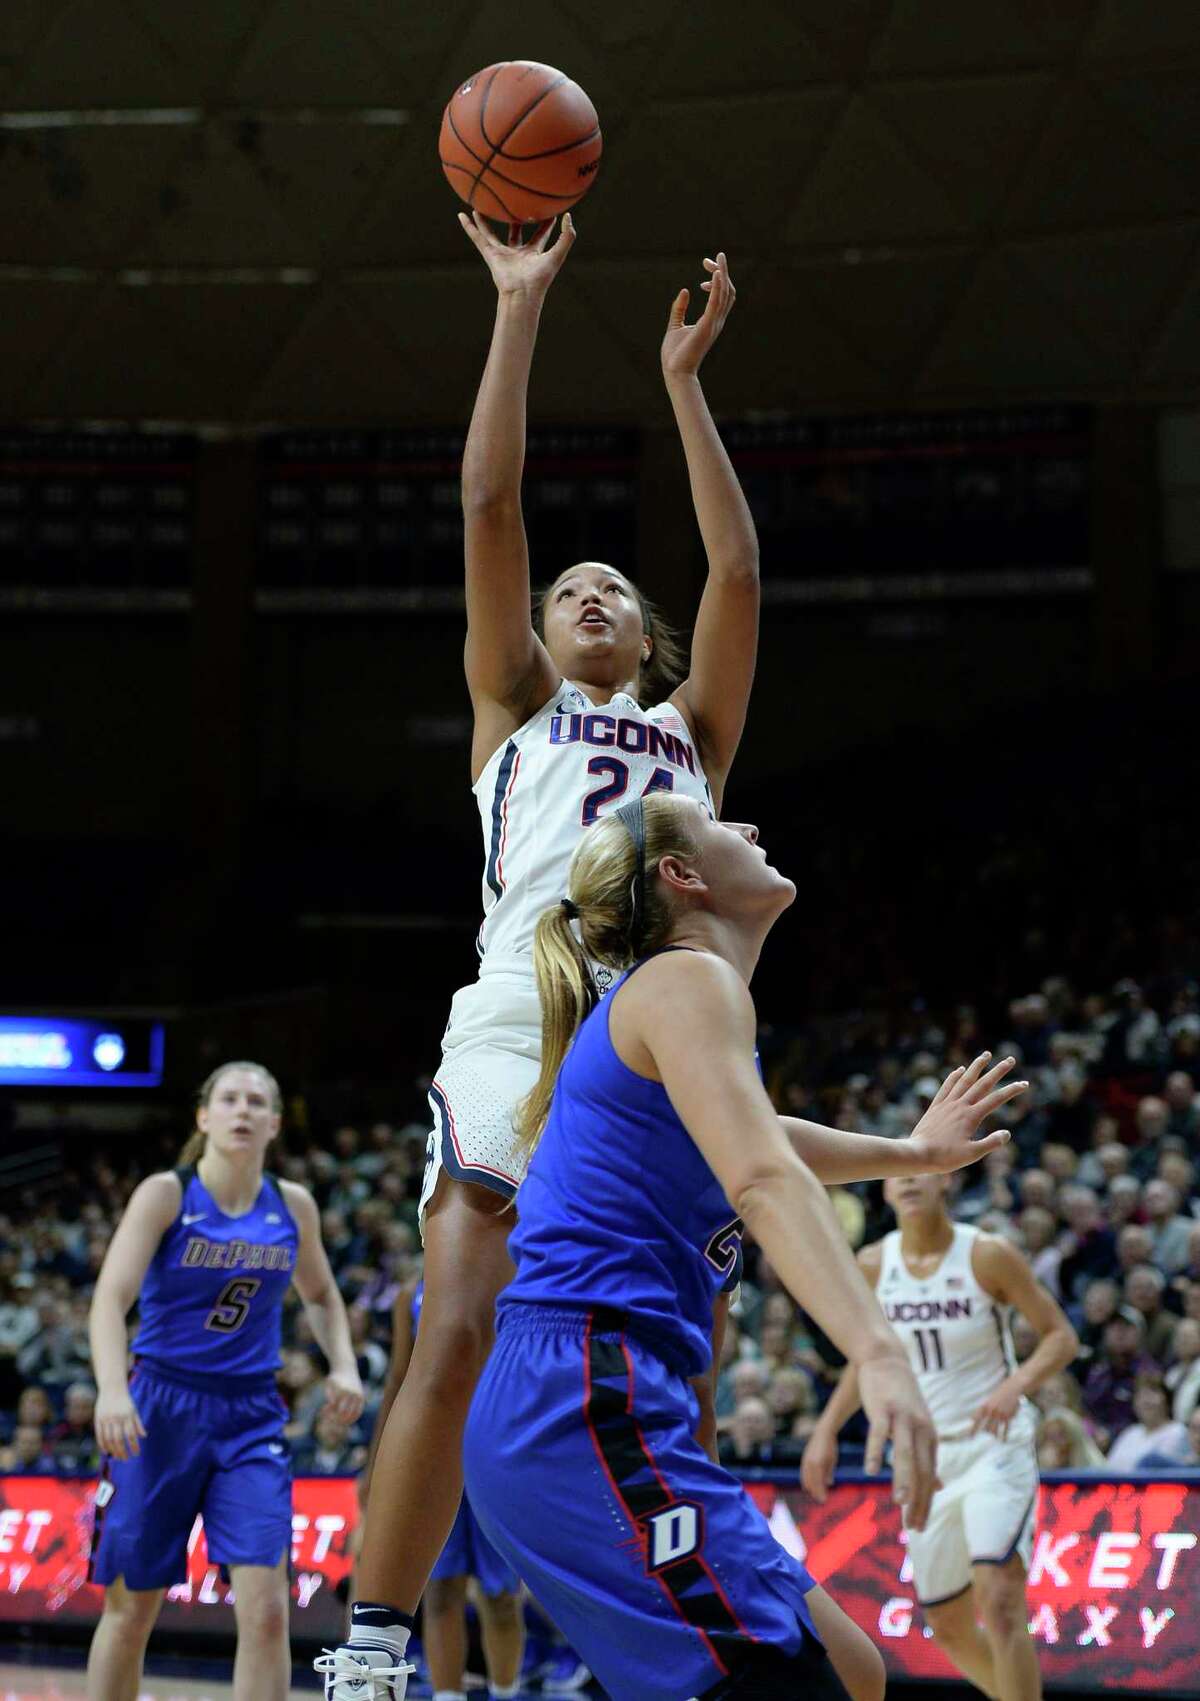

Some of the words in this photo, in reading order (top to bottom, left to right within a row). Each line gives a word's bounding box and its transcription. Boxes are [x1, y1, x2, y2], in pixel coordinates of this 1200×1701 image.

[550, 713, 697, 778] UCONN
[886, 1298, 971, 1322] UCONN
[914, 1328, 943, 1371] 11
[651, 1504, 698, 1567] D
[877, 1596, 1177, 1649] GAXY
